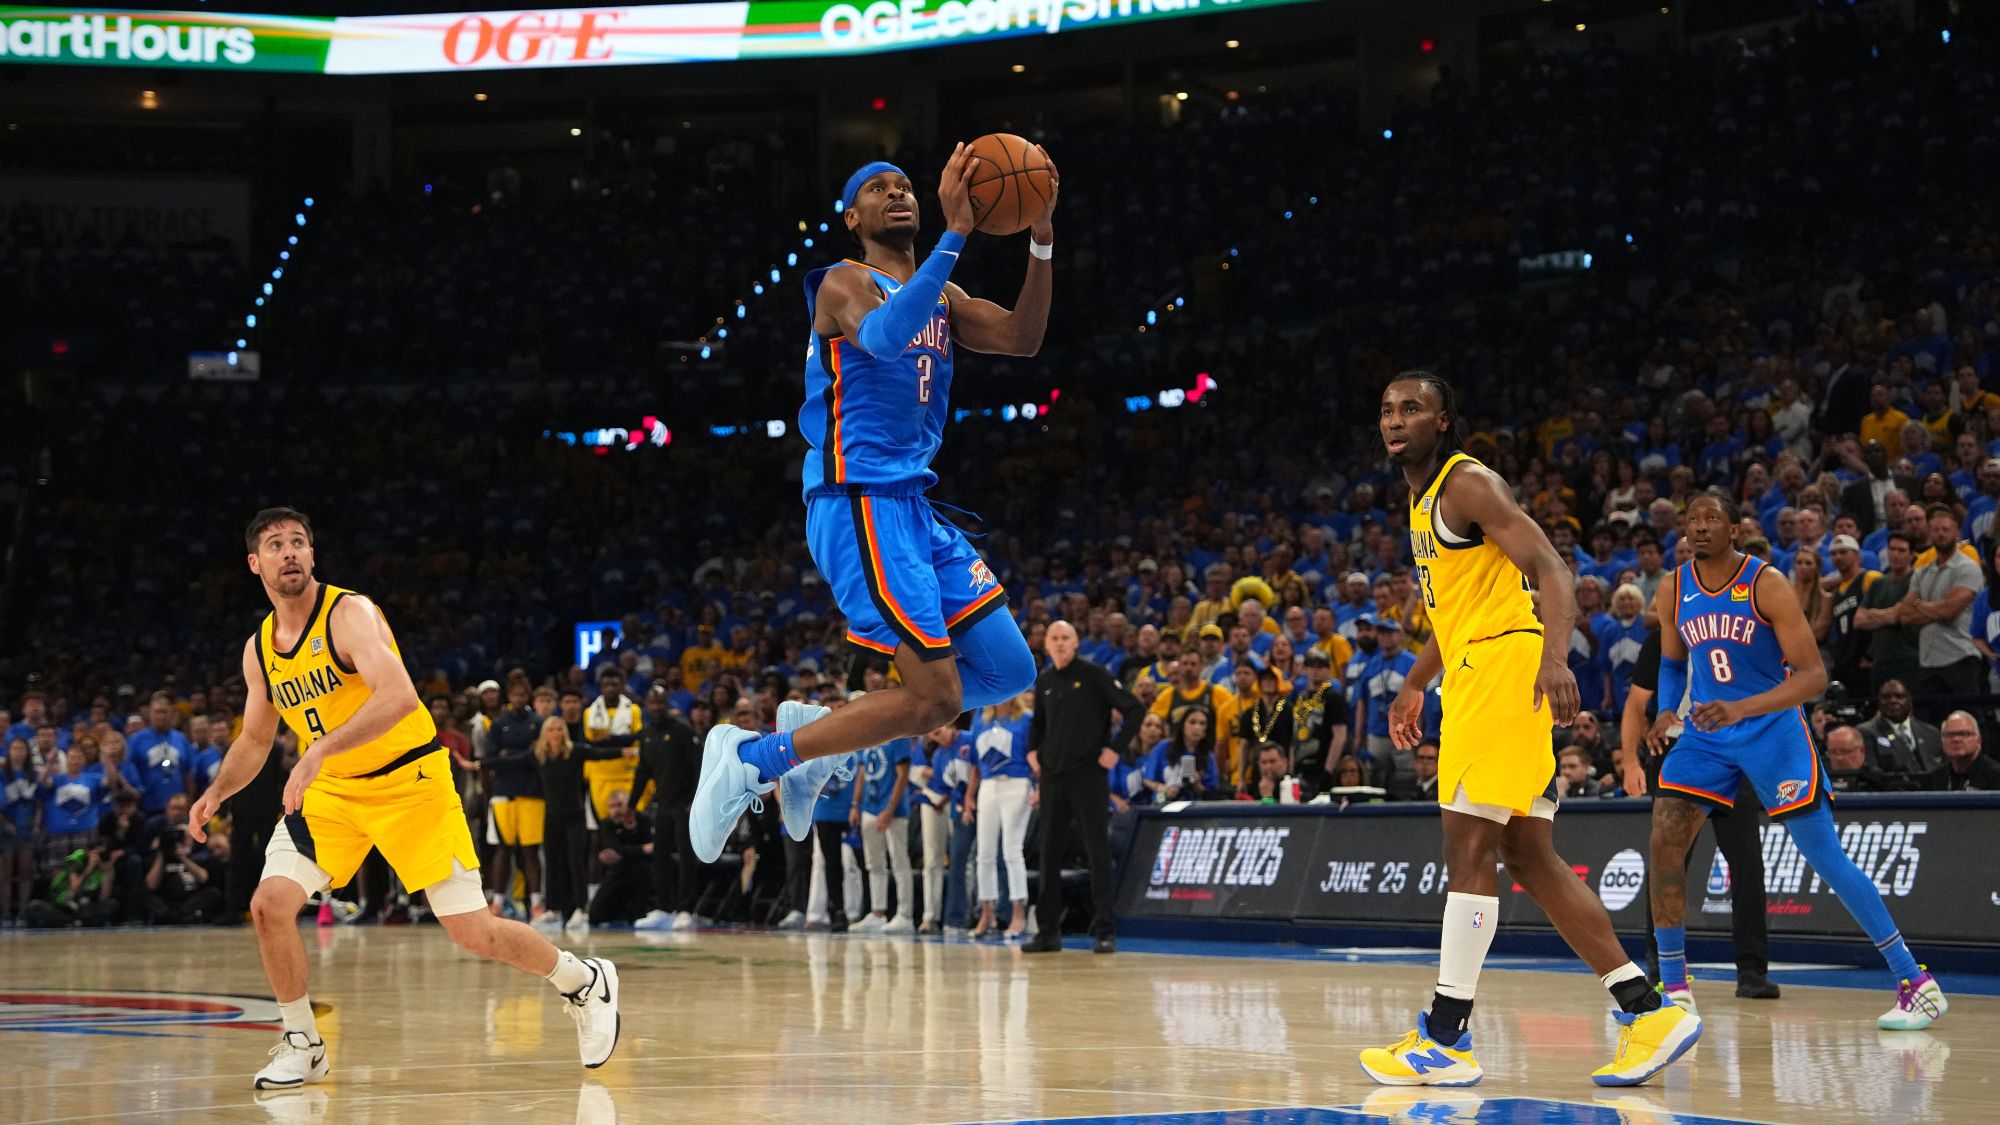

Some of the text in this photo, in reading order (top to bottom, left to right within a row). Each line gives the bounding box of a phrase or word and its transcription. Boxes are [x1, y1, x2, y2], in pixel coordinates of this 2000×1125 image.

[916, 353, 933, 404] 2
[1680, 613, 1756, 648] THUNDER
[1709, 648, 1732, 683] 8
[304, 707, 327, 741] 9
[1166, 827, 1290, 886] DRAFT 2025
[1320, 861, 1376, 893] JUNE
[1378, 861, 1410, 894] 25
[1418, 862, 1437, 894] 8
[1603, 867, 1641, 888] abc
